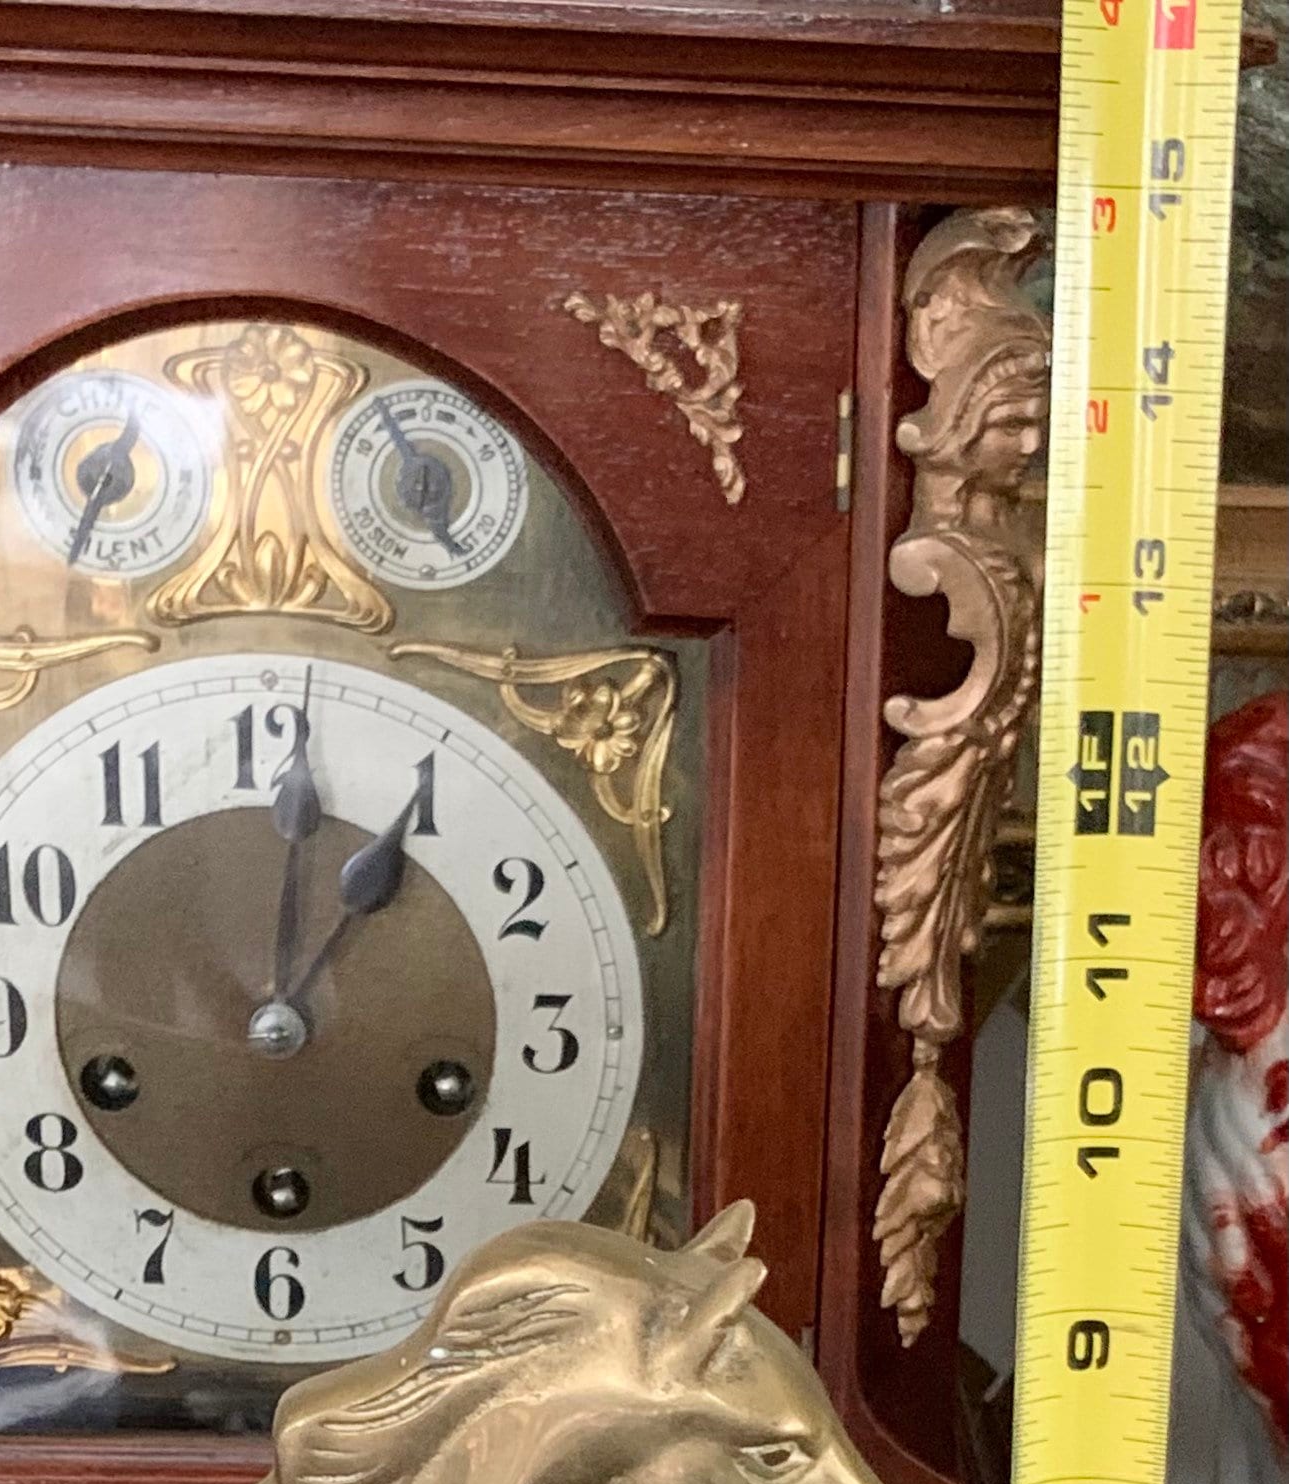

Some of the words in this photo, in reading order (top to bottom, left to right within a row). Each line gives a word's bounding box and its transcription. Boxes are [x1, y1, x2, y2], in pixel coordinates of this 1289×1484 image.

[1092, 197, 1116, 233] 3
[1149, 138, 1185, 221] 15
[1086, 400, 1108, 433] 2
[1141, 340, 1175, 421] 14
[1078, 594, 1101, 614] 1
[1132, 538, 1165, 616] 13
[99, 740, 164, 829] 11
[227, 703, 312, 791] 12
[1124, 736, 1156, 814] 12
[410, 752, 439, 838] 1
[491, 857, 548, 941] 2
[1085, 914, 1131, 1001] 11
[521, 994, 579, 1077] 3
[24, 1113, 84, 1193] 8
[1077, 1067, 1123, 1179] 10
[484, 1128, 547, 1206] 4
[133, 1209, 177, 1286] 7
[252, 1246, 306, 1323] 6
[392, 1216, 445, 1292] 5
[1066, 1319, 1110, 1371] 9
